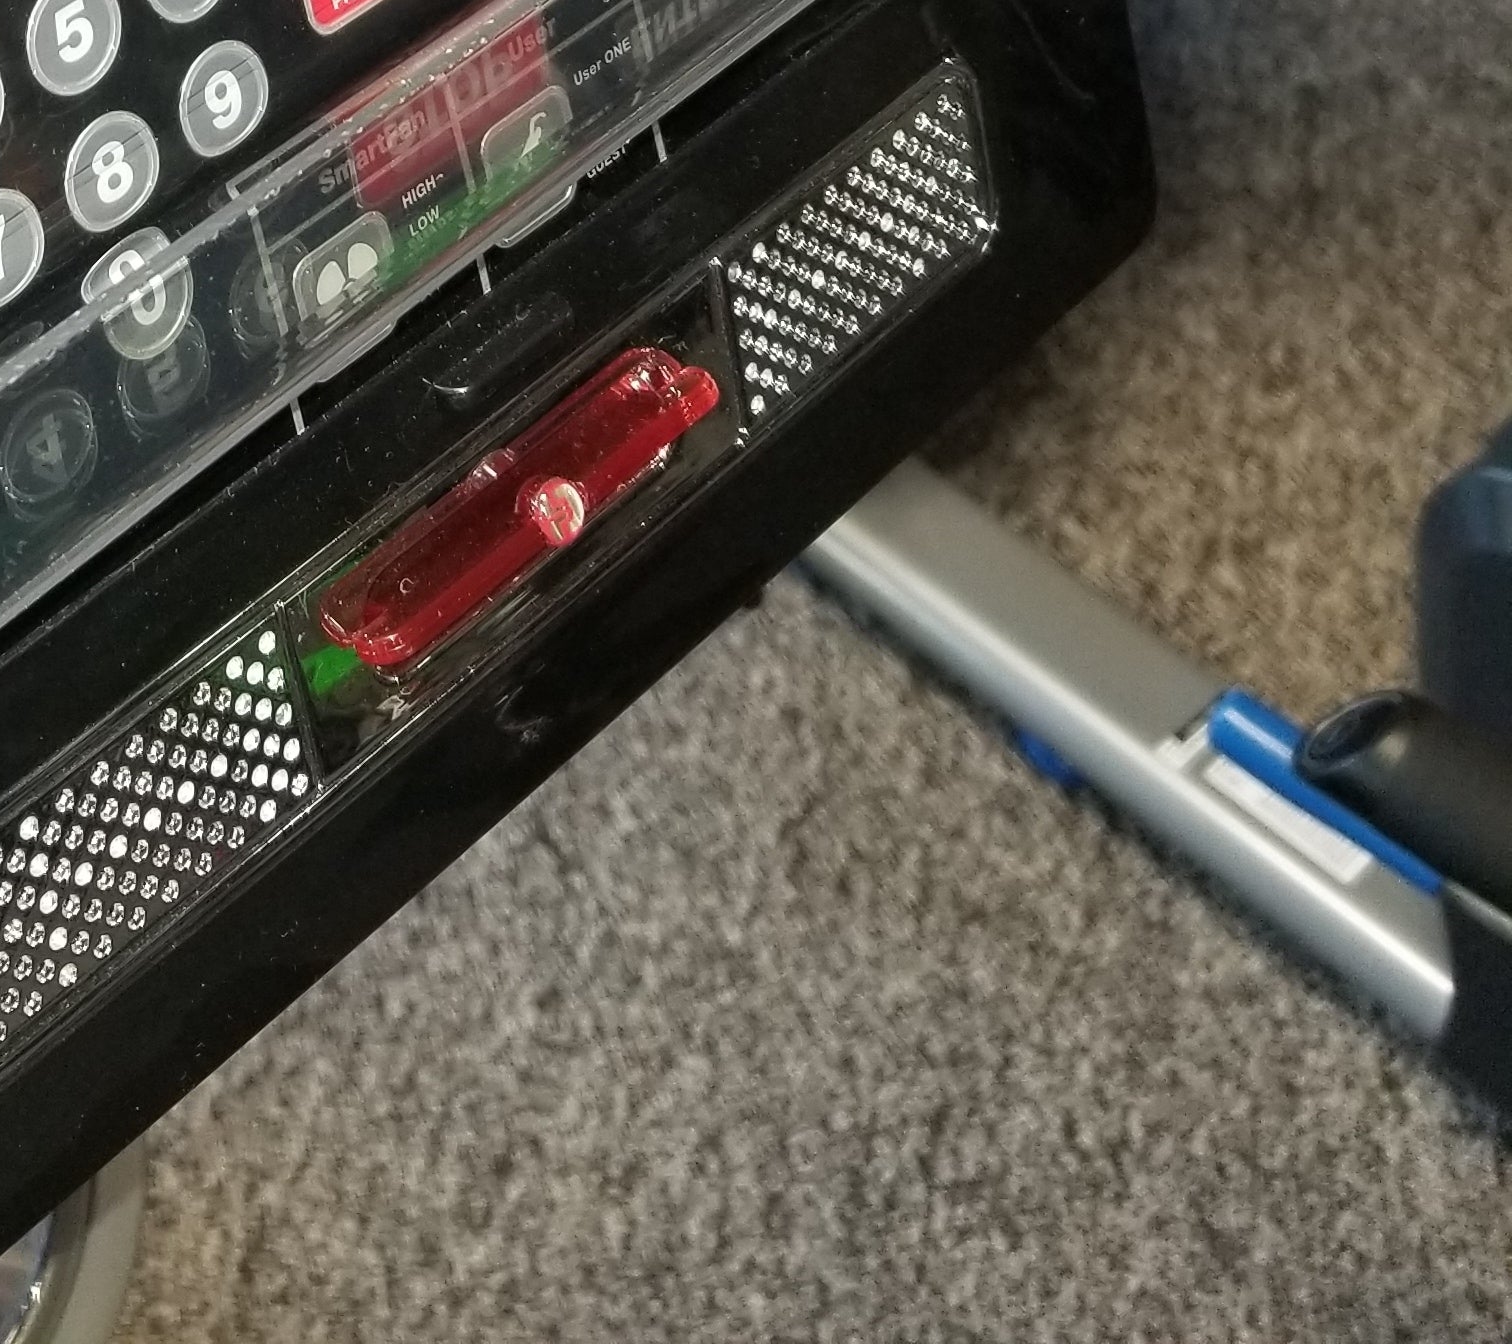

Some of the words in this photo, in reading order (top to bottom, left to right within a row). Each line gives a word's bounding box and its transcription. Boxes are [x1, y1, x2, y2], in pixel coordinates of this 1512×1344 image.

[573, 58, 602, 88] User
[602, 36, 633, 65] ONE
[95, 139, 135, 205] 8
[204, 69, 244, 129] 9
[408, 205, 441, 238] LOW
